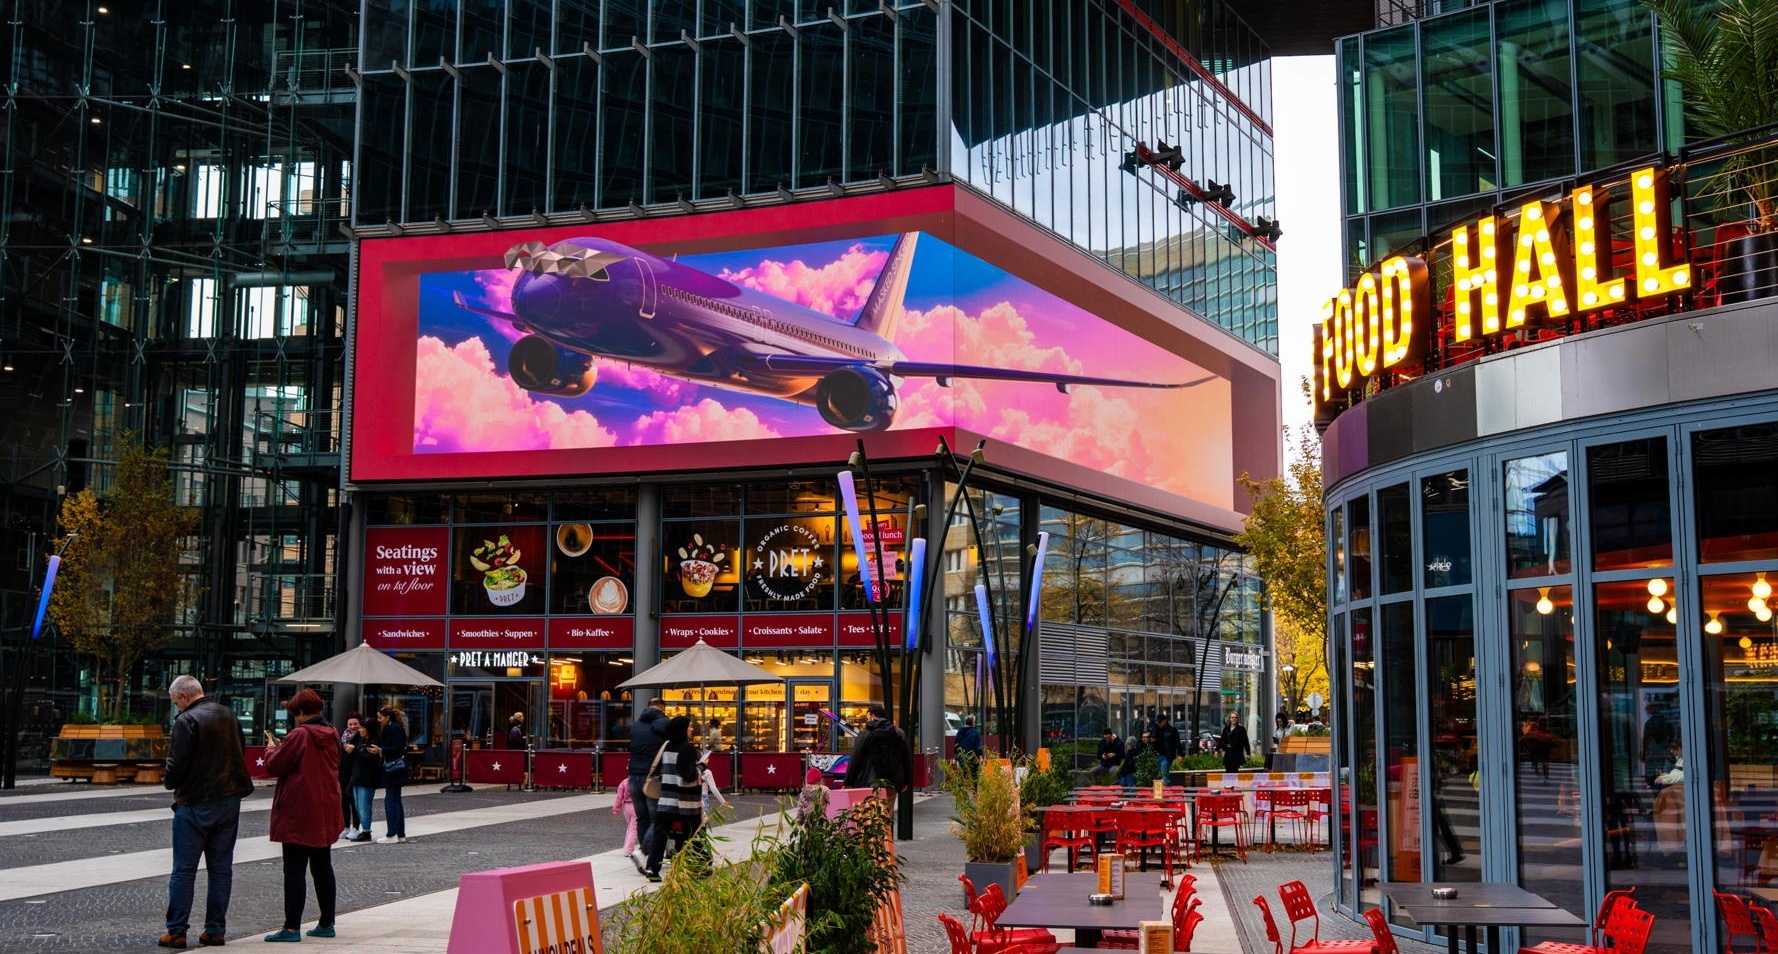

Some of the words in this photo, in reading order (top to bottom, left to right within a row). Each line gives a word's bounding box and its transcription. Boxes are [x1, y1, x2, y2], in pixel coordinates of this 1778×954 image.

[1322, 255, 1412, 402] FOOD
[1452, 167, 1692, 343] HALL
[757, 524, 790, 553] ORGANIC
[793, 524, 821, 551] COFFEE
[882, 530, 903, 539] lunch
[376, 545, 438, 562] Seatings
[376, 565, 395, 575] with
[395, 567, 402, 575] a
[403, 562, 437, 576] view
[769, 548, 810, 578] PRET
[377, 583, 391, 591] on
[400, 577, 434, 595] floor
[756, 574, 783, 602] FRESHLY
[783, 590, 805, 602] MADE
[805, 571, 821, 594] FOOD
[499, 593, 515, 603] PRET
[382, 629, 426, 638] Sandwiches
[461, 628, 500, 638] Smoothies
[504, 629, 534, 640] Suppen
[571, 628, 610, 637] Bio-Kaffee
[670, 627, 694, 637] Wraps
[699, 627, 729, 636] Cookies
[753, 626, 793, 635] Croissants
[798, 625, 823, 634] Salate
[848, 625, 865, 634] Tees
[460, 651, 482, 667] PRET
[484, 652, 491, 667] A
[493, 651, 529, 667] MANGER
